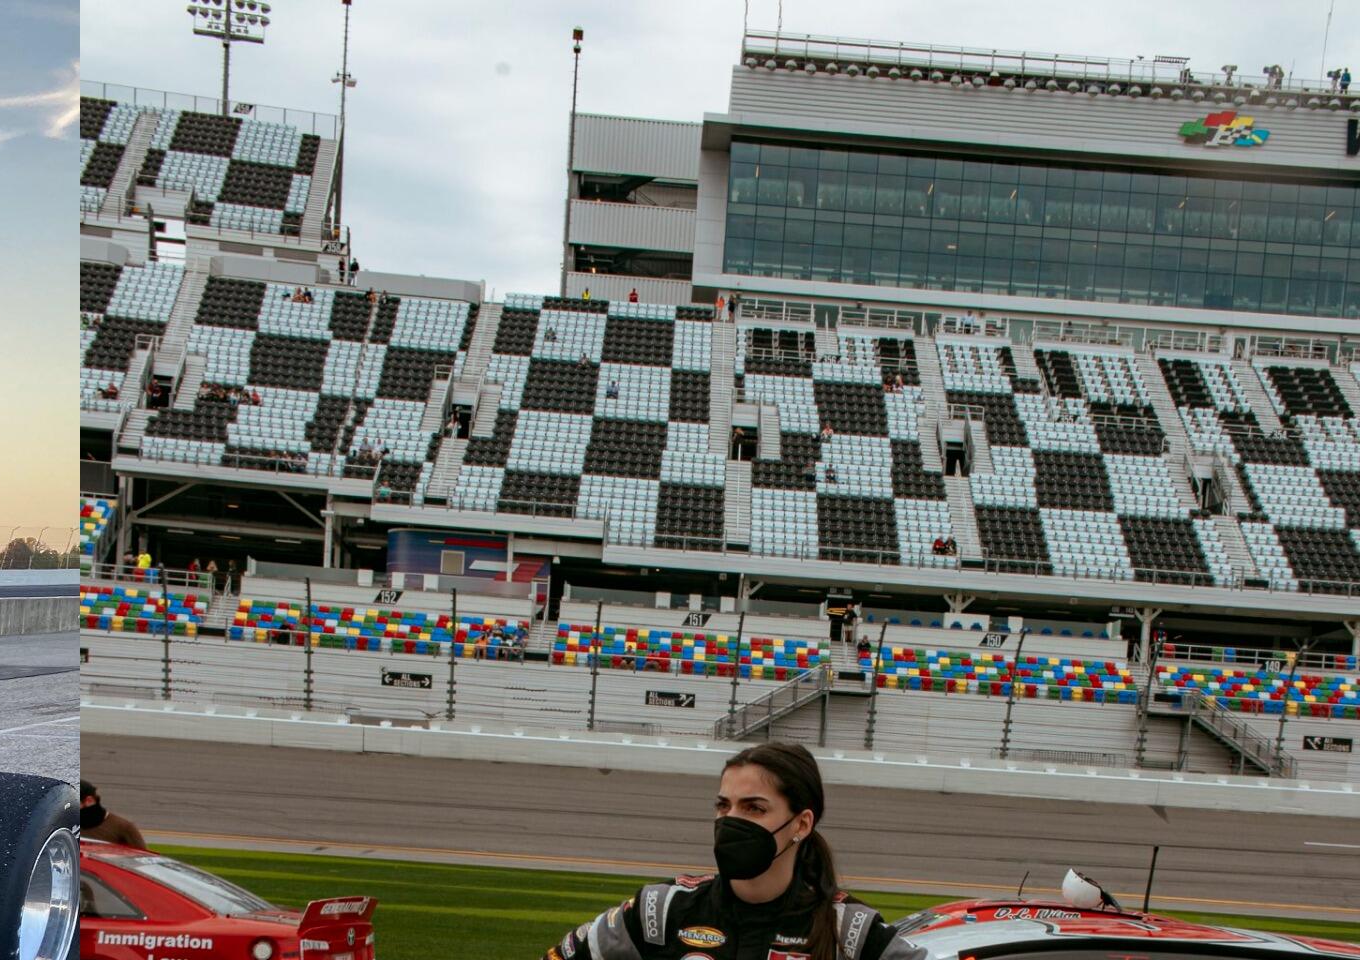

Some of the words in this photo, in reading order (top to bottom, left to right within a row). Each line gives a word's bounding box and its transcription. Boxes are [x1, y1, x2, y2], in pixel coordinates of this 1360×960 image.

[380, 591, 397, 604] 152
[689, 613, 703, 626] 151
[987, 635, 1001, 647] 150
[1265, 660, 1280, 673] 149
[647, 890, 659, 938] sparco
[97, 931, 213, 949] Immigration
[678, 929, 726, 943] MENARDS
[775, 934, 808, 944] MENA
